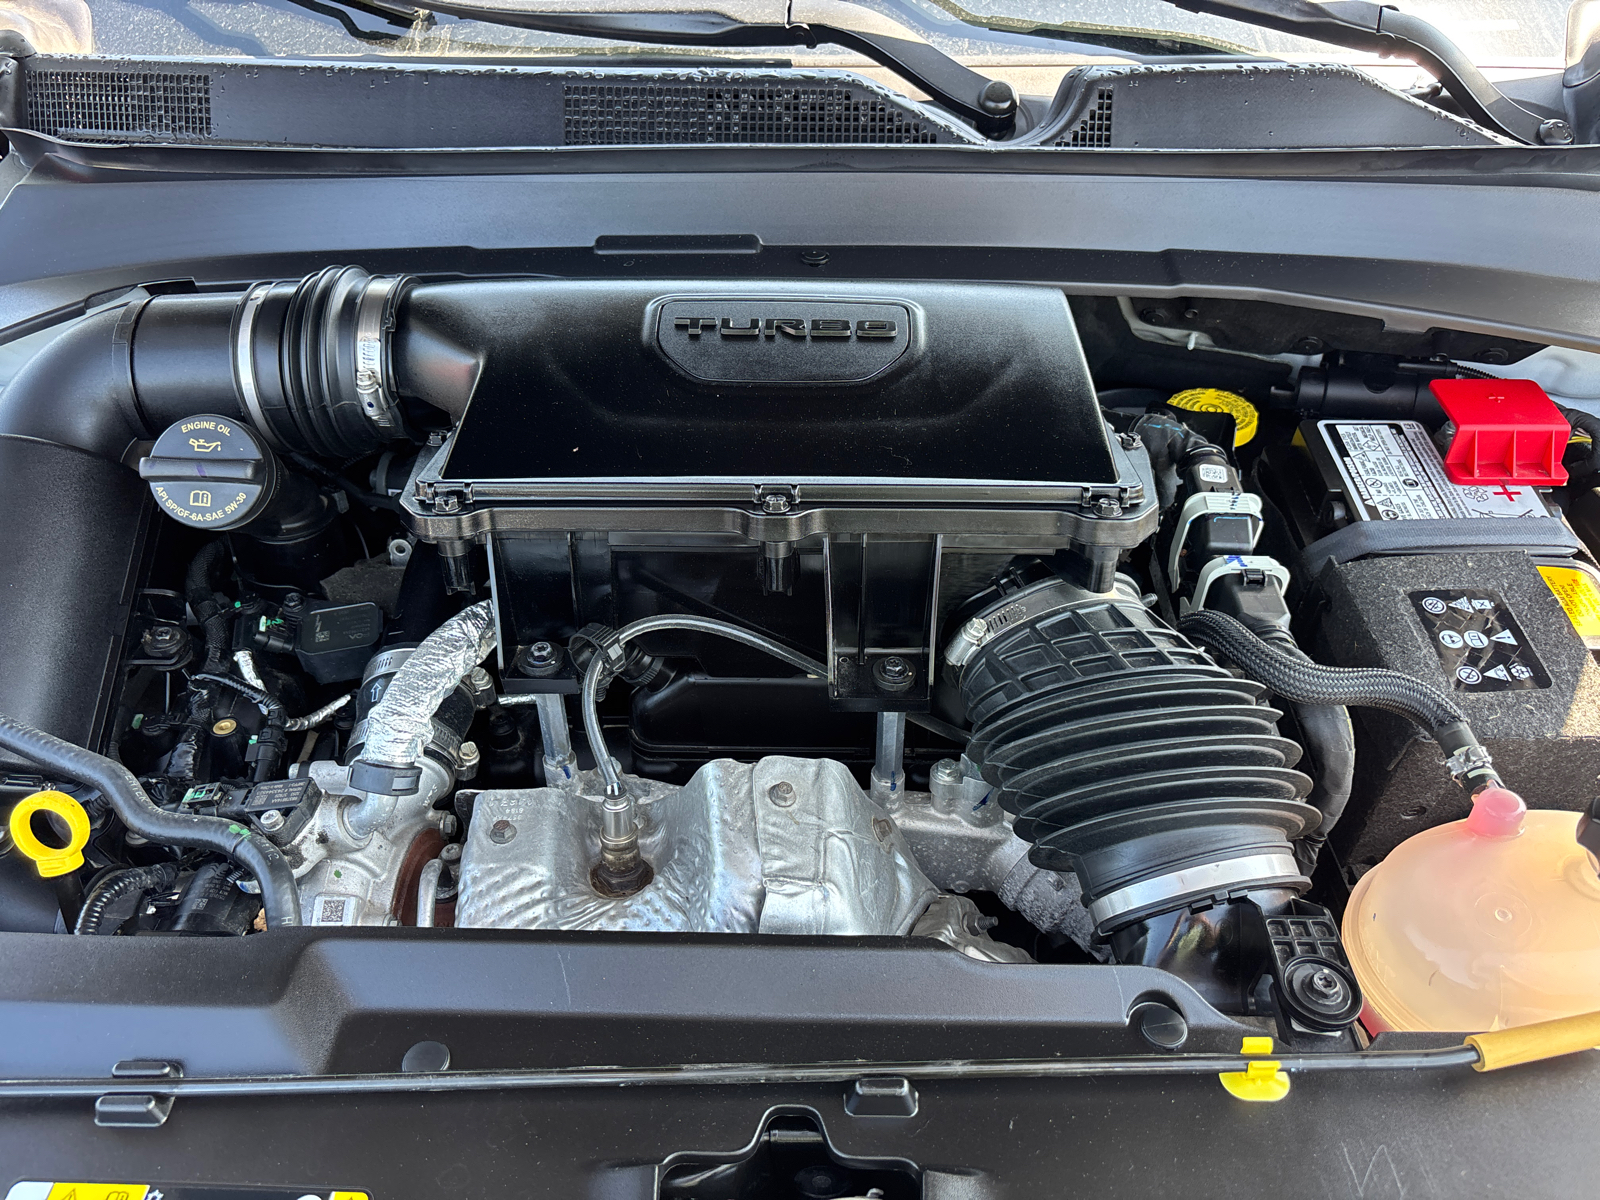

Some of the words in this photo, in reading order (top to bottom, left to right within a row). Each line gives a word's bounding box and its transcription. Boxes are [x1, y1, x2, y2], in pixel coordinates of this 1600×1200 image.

[673, 316, 898, 338] TURBO
[181, 421, 216, 434] ENGINE
[217, 424, 231, 436] OIL
[155, 486, 169, 502] API
[224, 492, 247, 514] 5W-30
[1545, 575, 1563, 595] BATTERY
